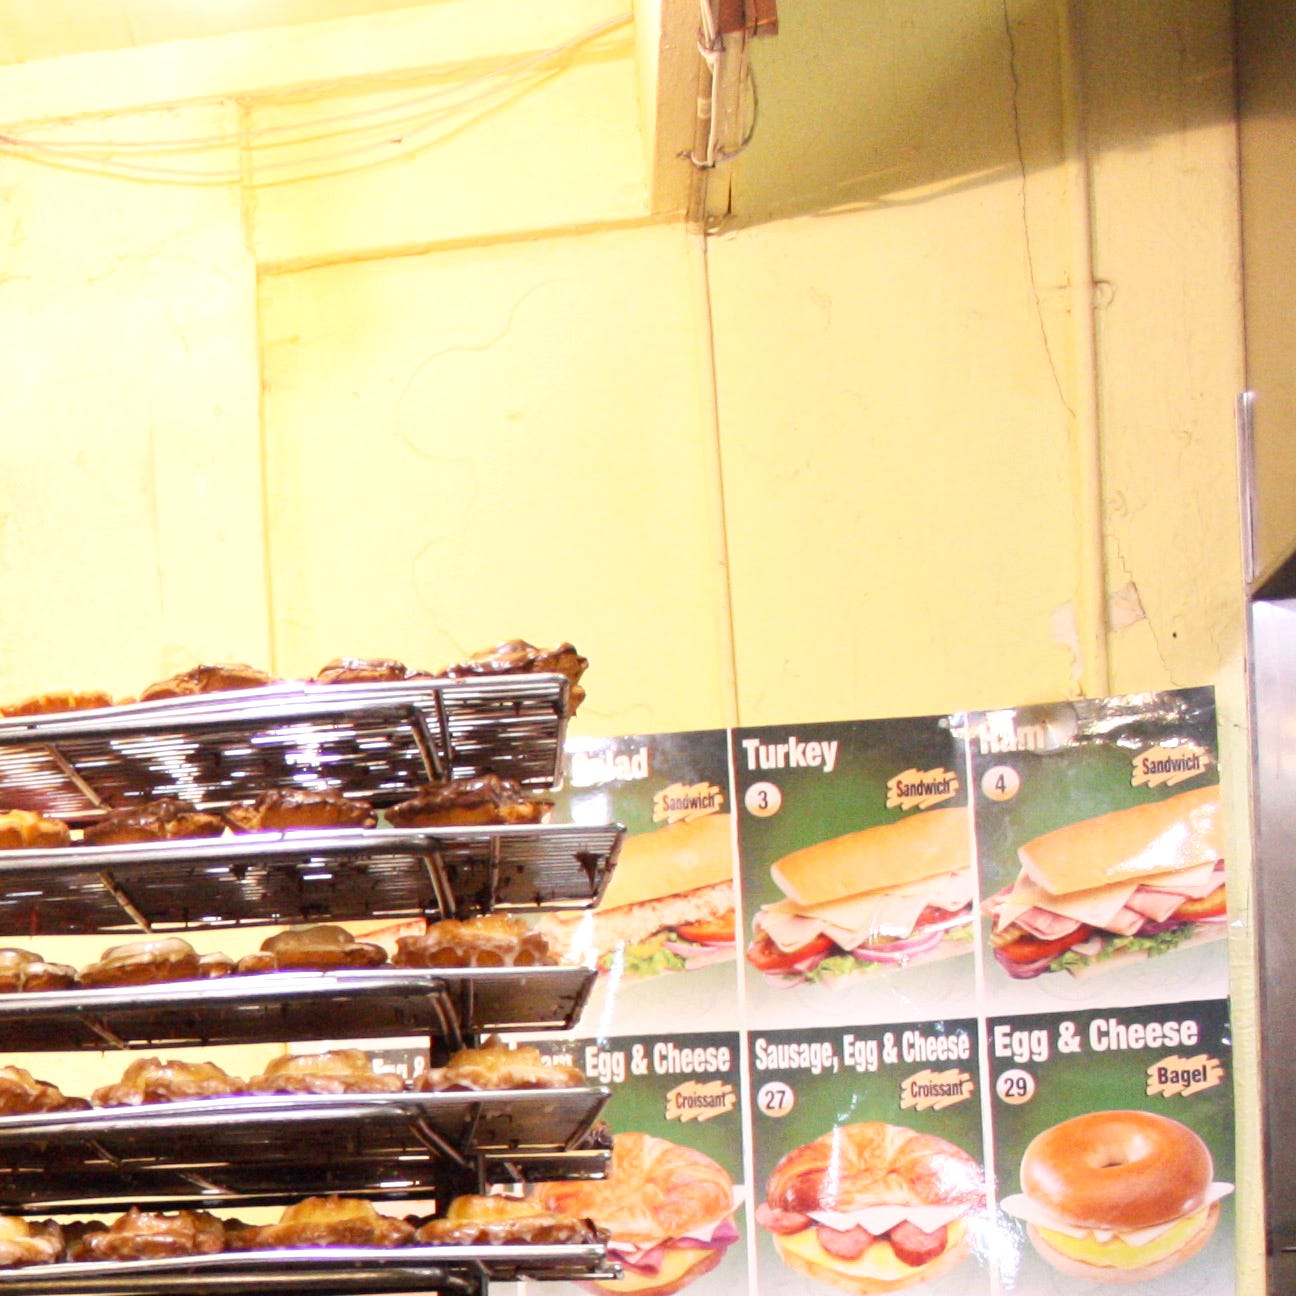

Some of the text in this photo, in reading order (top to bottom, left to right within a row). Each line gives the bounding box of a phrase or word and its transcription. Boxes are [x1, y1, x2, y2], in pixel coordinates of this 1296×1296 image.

[742, 736, 839, 773] Turkey
[1141, 753, 1201, 776] Sandwich
[896, 778, 951, 798] Sandwich
[994, 773, 1007, 794] 4
[662, 793, 715, 812] Sandwich
[757, 789, 768, 810] 3
[993, 1018, 1199, 1064] Egg & Cheese
[584, 1045, 625, 1084] Egg
[630, 1043, 648, 1076] &
[653, 1042, 731, 1075] Cheese
[755, 1030, 970, 1075] Sausage, Egg & Cheese
[1157, 1064, 1208, 1088] Bagel
[910, 1080, 965, 1099] Croissant
[1003, 1076, 1028, 1098] 29
[675, 1091, 727, 1109] Croissant
[764, 1089, 786, 1110] 27
